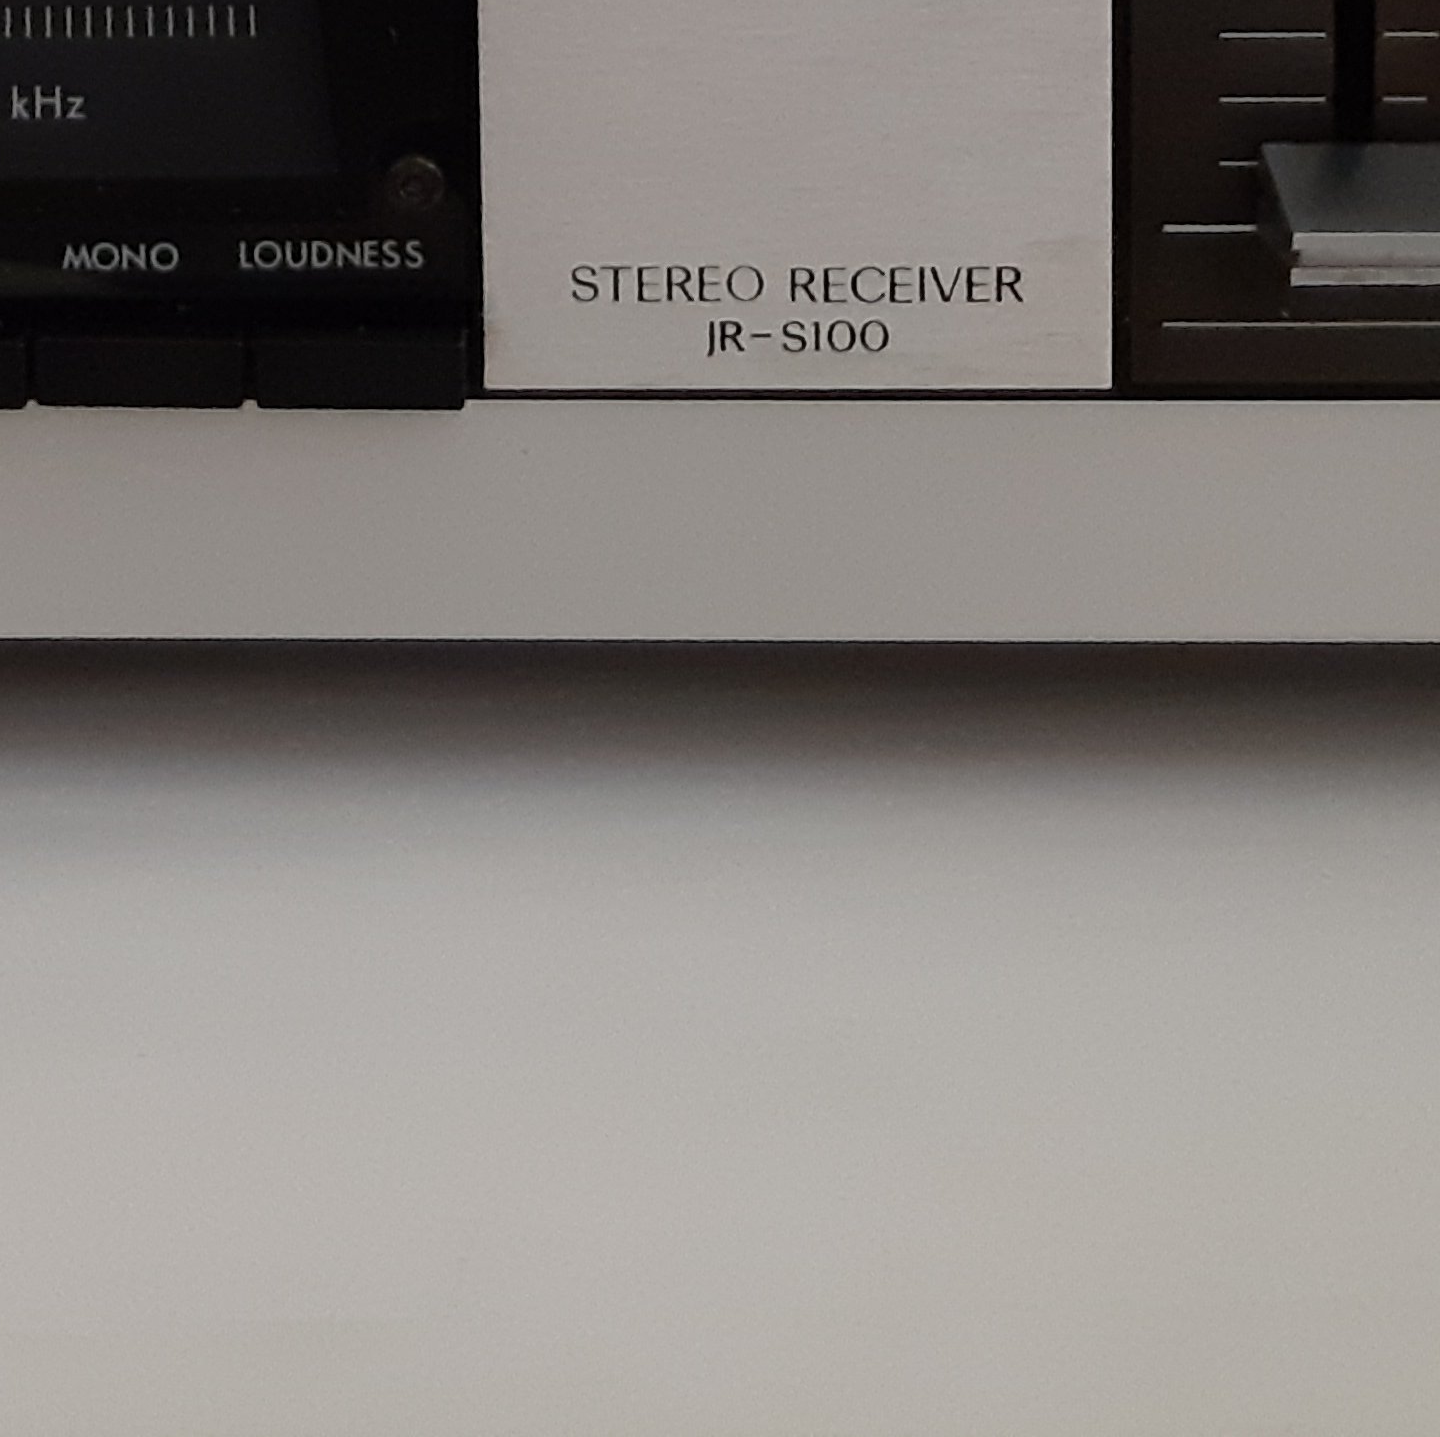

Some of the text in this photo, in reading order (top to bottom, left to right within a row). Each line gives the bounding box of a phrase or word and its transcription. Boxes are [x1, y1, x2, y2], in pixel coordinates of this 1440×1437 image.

[11, 85, 85, 120] kHz
[62, 242, 179, 272] MONO
[239, 239, 424, 270] LOUDNESS
[571, 265, 1024, 304] STEREO RECEIVER
[707, 319, 890, 358] JR-S100
